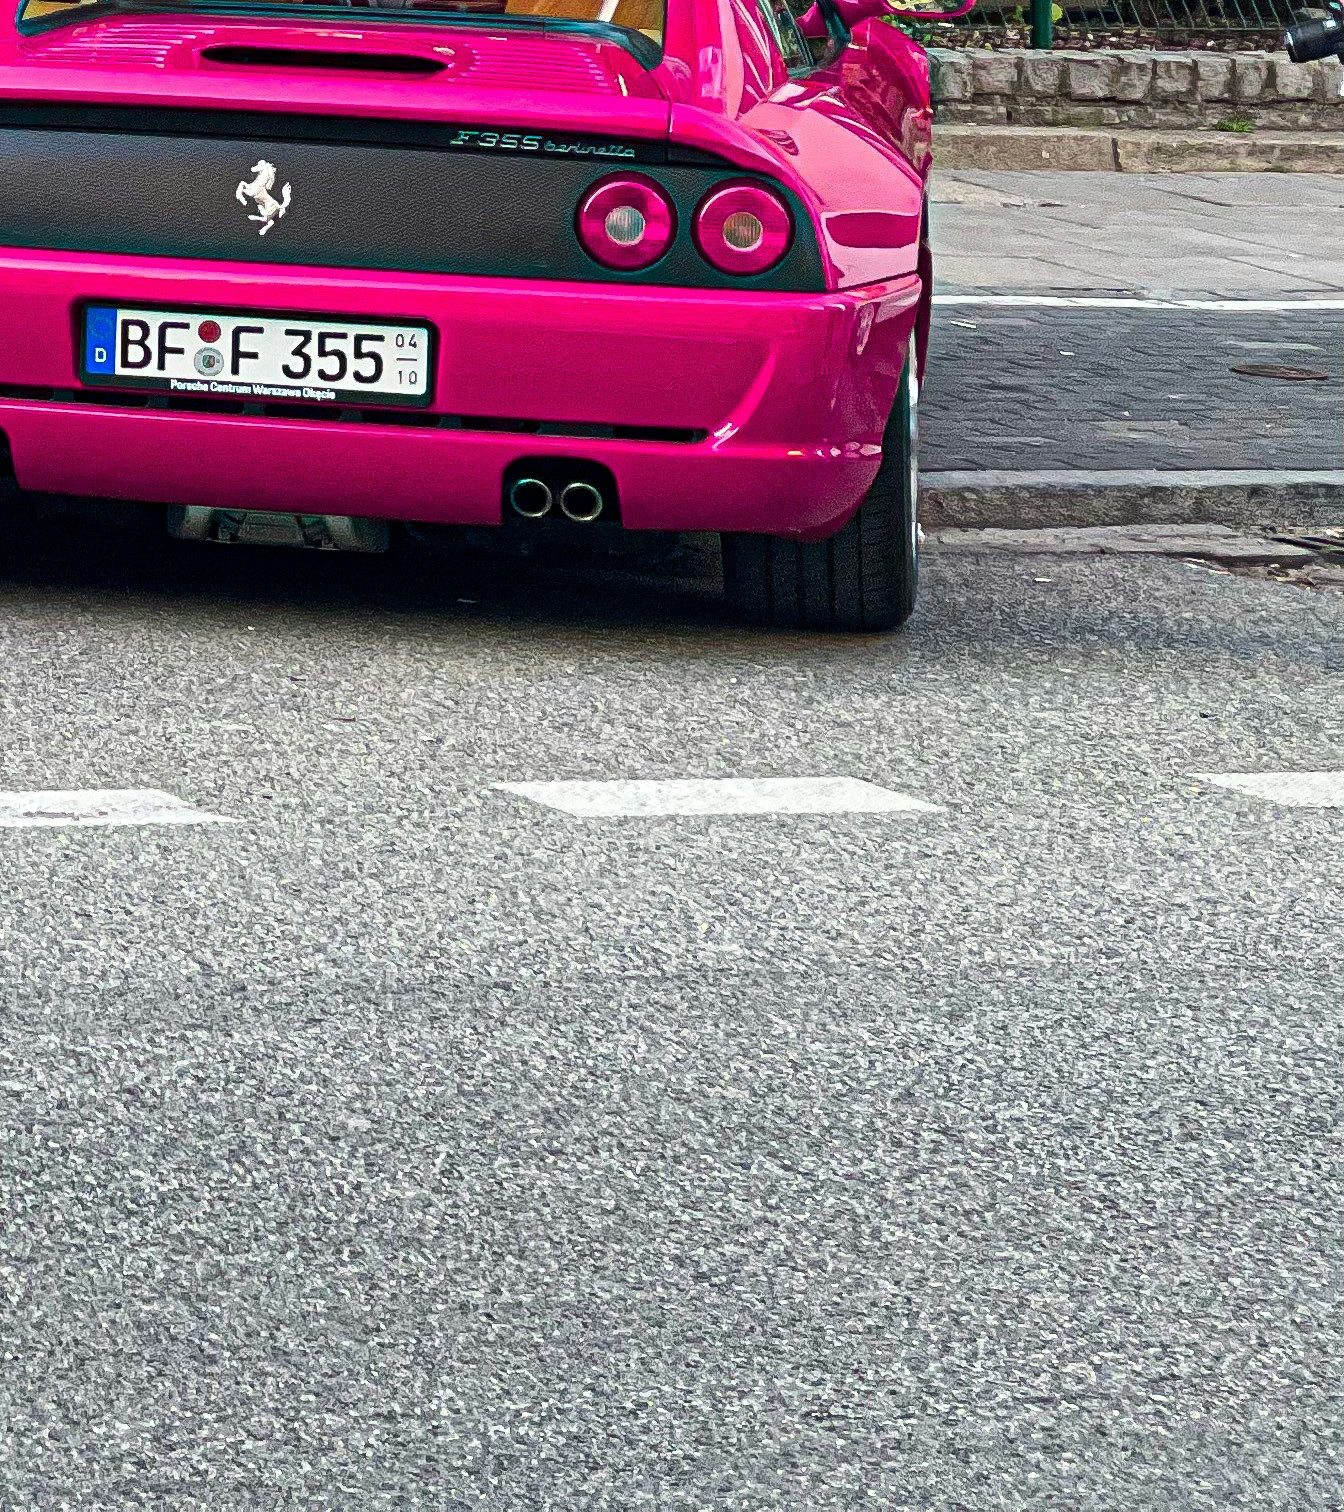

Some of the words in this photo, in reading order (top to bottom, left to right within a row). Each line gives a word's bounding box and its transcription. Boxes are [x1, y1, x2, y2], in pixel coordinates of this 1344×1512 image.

[450, 130, 543, 150] F355
[394, 332, 418, 349] 04
[95, 348, 107, 363] D
[119, 318, 190, 370] BF
[230, 325, 264, 376] F
[281, 328, 385, 383] 355
[397, 369, 418, 385] 10
[170, 379, 209, 392] Porsche
[209, 381, 252, 395] Centrum
